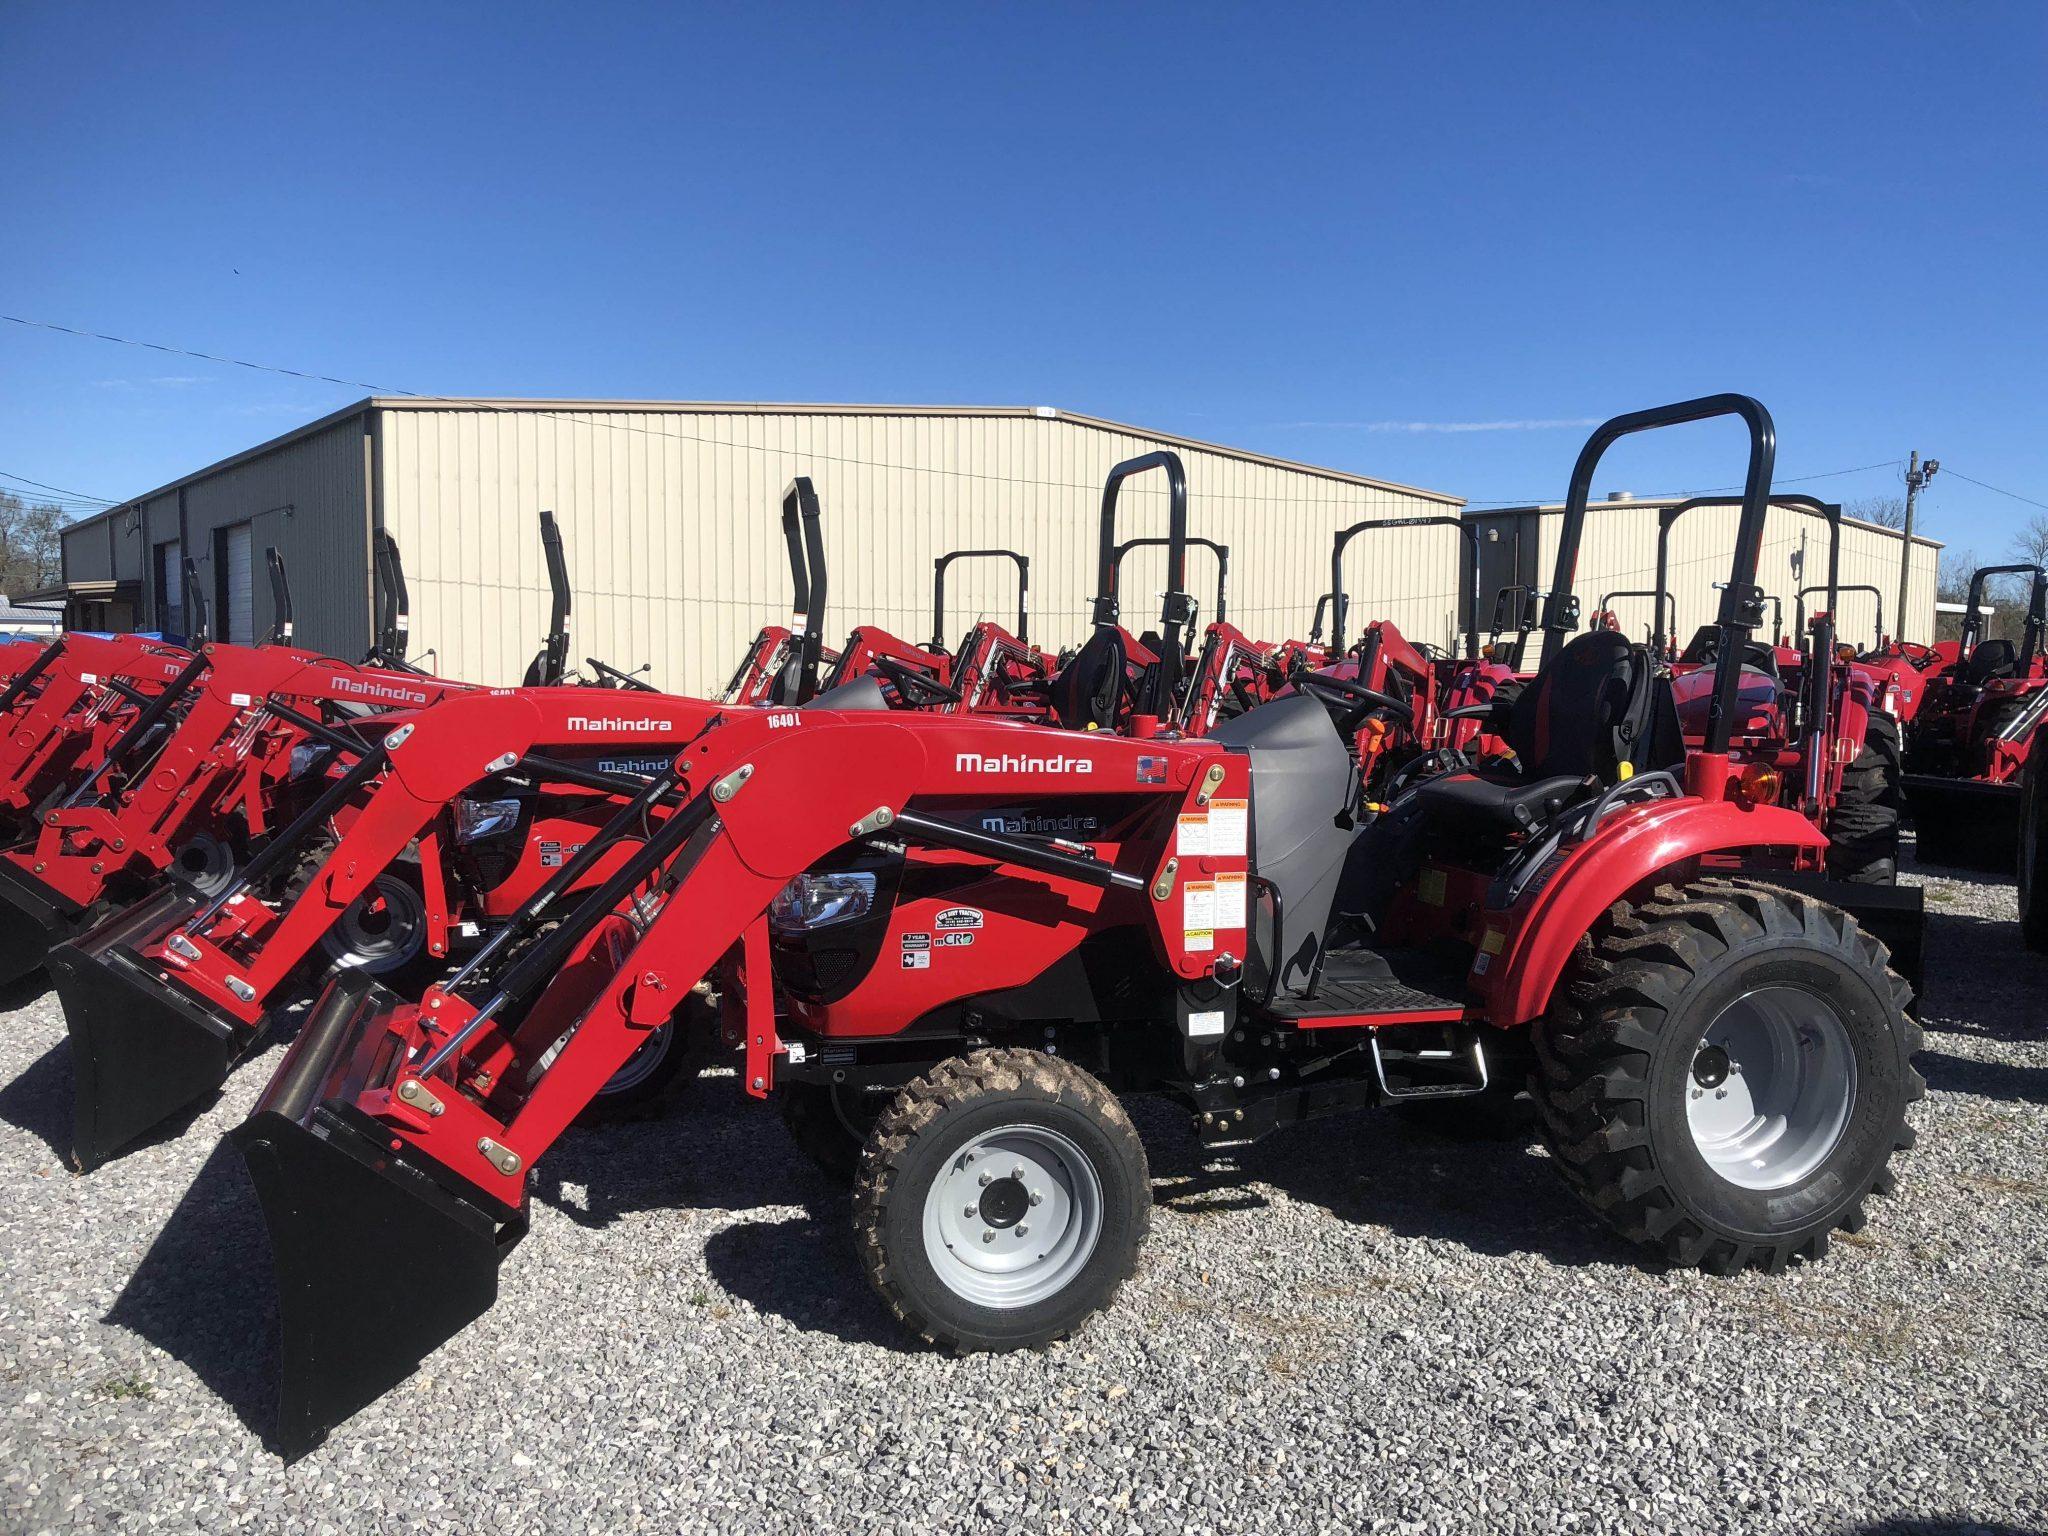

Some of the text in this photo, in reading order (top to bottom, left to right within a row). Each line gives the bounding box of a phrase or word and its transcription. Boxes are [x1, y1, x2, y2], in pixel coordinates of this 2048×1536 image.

[331, 676, 426, 703] Mahindra
[567, 716, 672, 731] Mahindra
[767, 713, 794, 729] 1640
[598, 758, 672, 772] Mahind
[956, 753, 1093, 773] Mahindra
[982, 814, 1098, 833] Mahindra
